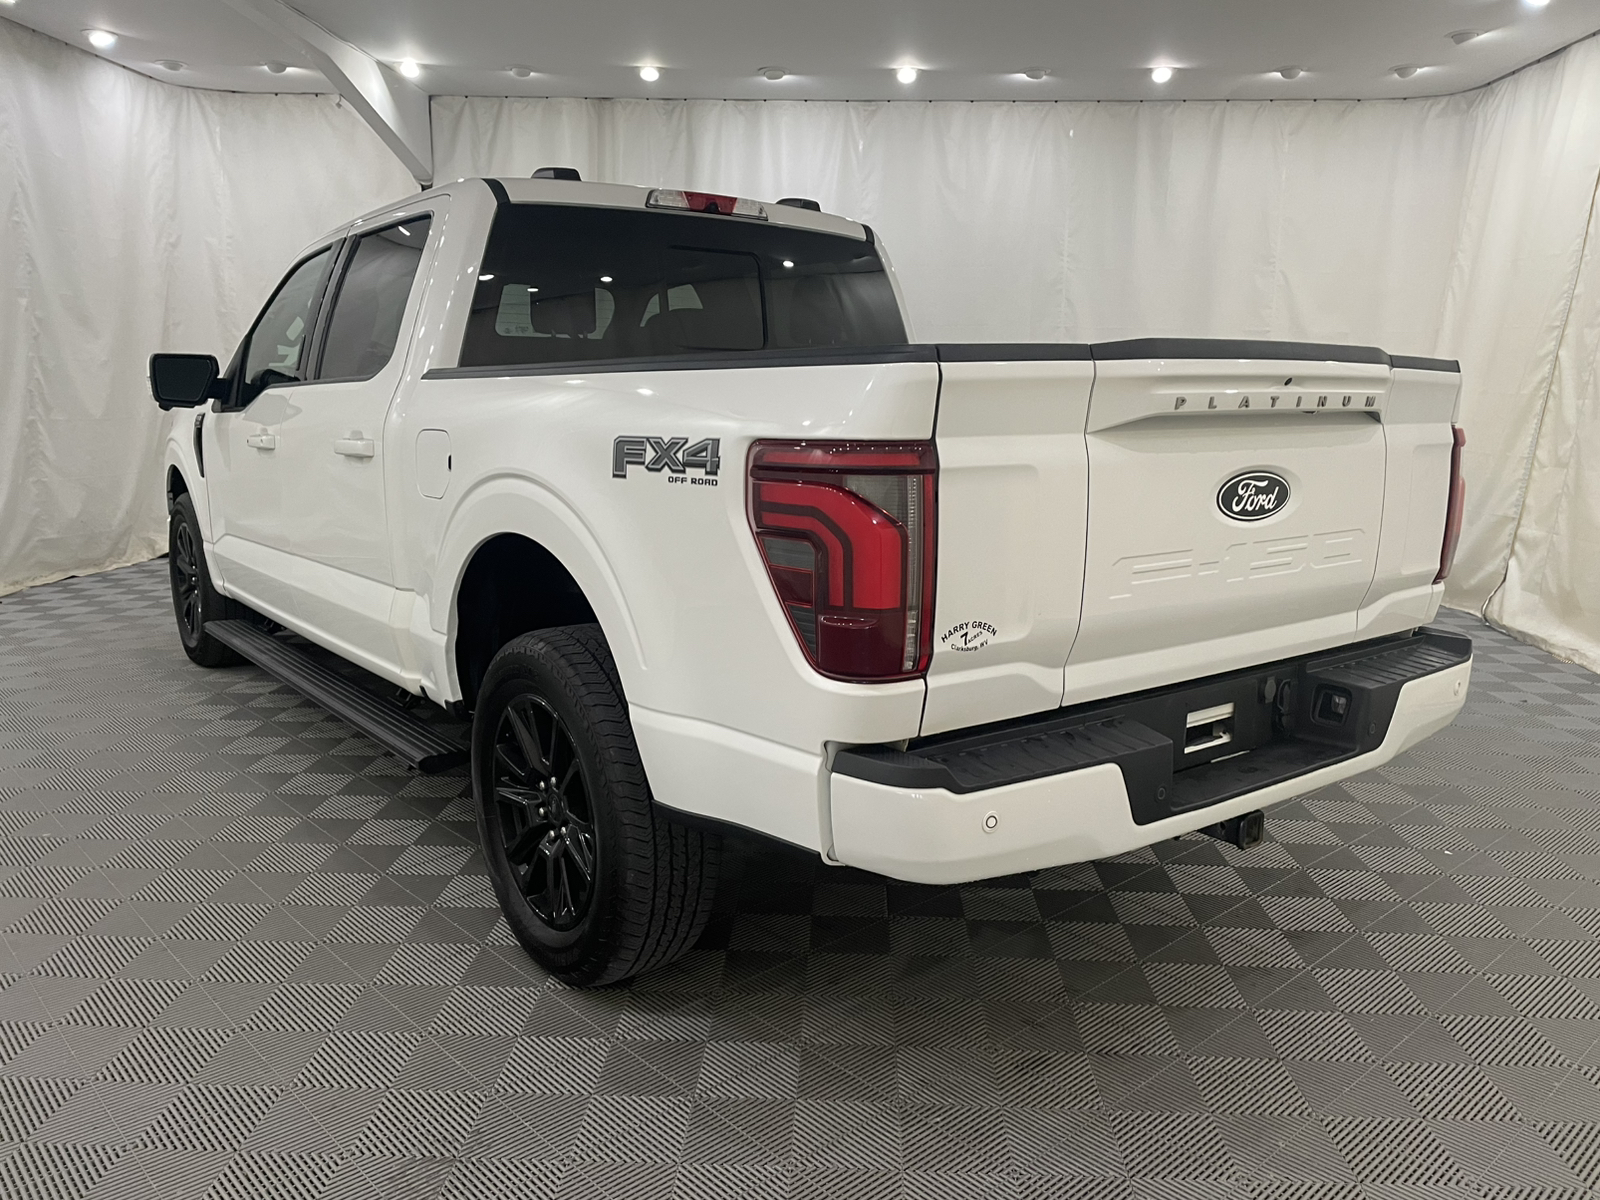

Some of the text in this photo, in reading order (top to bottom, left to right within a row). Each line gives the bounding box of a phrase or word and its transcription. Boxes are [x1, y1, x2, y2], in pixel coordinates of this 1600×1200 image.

[1174, 396, 1376, 410] PLATINUM
[612, 435, 721, 479] FX4
[668, 476, 718, 486] OFF ROAD
[1232, 479, 1279, 512] Ford
[941, 621, 997, 643] HARRY GREEN
[960, 631, 968, 646] 7
